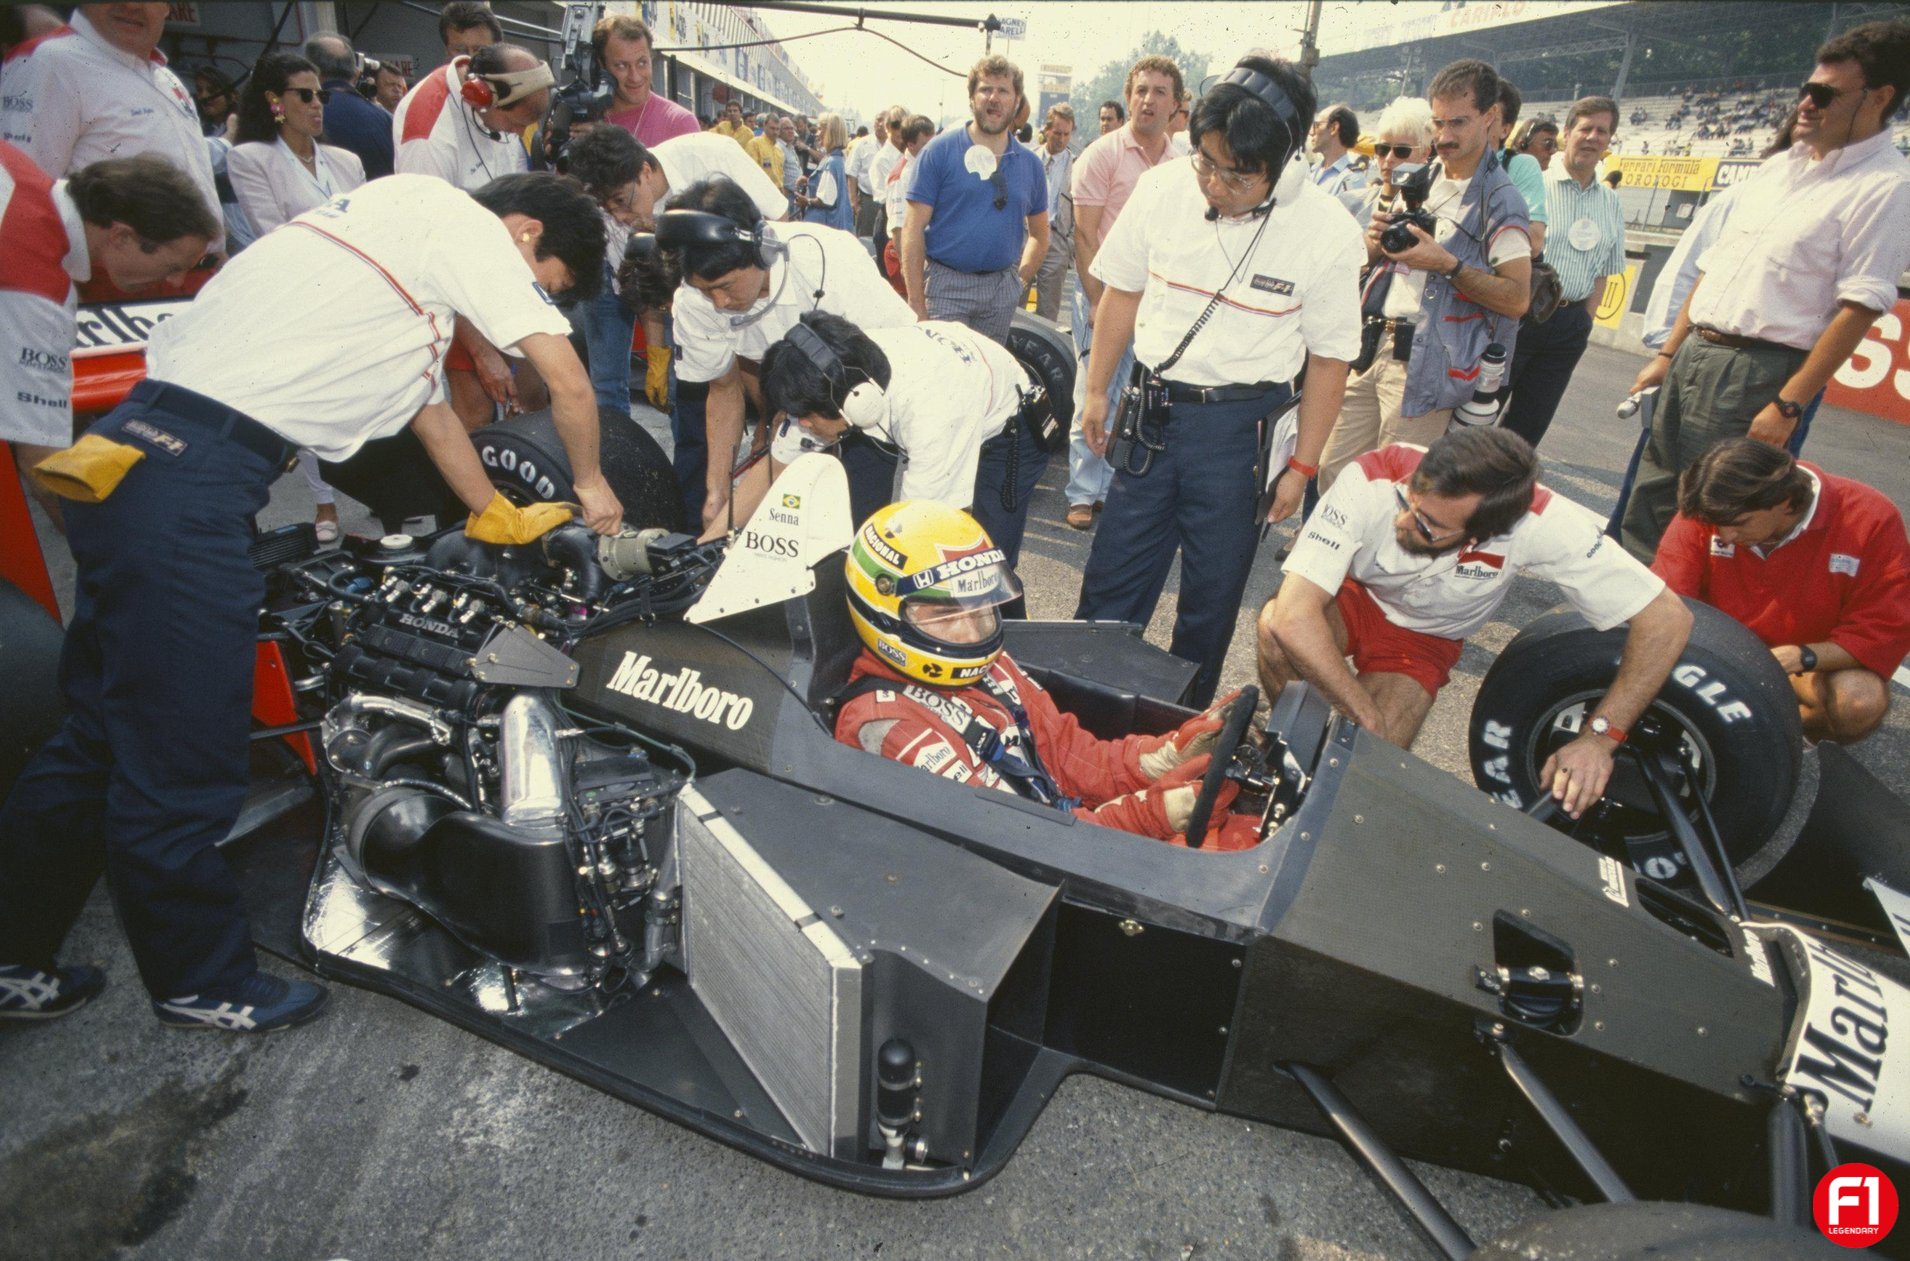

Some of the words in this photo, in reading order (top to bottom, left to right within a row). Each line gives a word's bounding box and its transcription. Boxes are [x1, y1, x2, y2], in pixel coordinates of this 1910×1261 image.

[21, 347, 67, 368] BOSS
[17, 391, 67, 408] Shell
[482, 445, 555, 499] GOOD
[769, 507, 799, 526] Senna
[1322, 504, 1348, 525] OSS
[745, 531, 799, 557] BOSS
[1308, 531, 1341, 551] Shell
[1456, 564, 1499, 578] Marlboro
[399, 613, 460, 639] HONDA
[606, 651, 753, 731] Marlboro
[910, 686, 965, 726] BOSS
